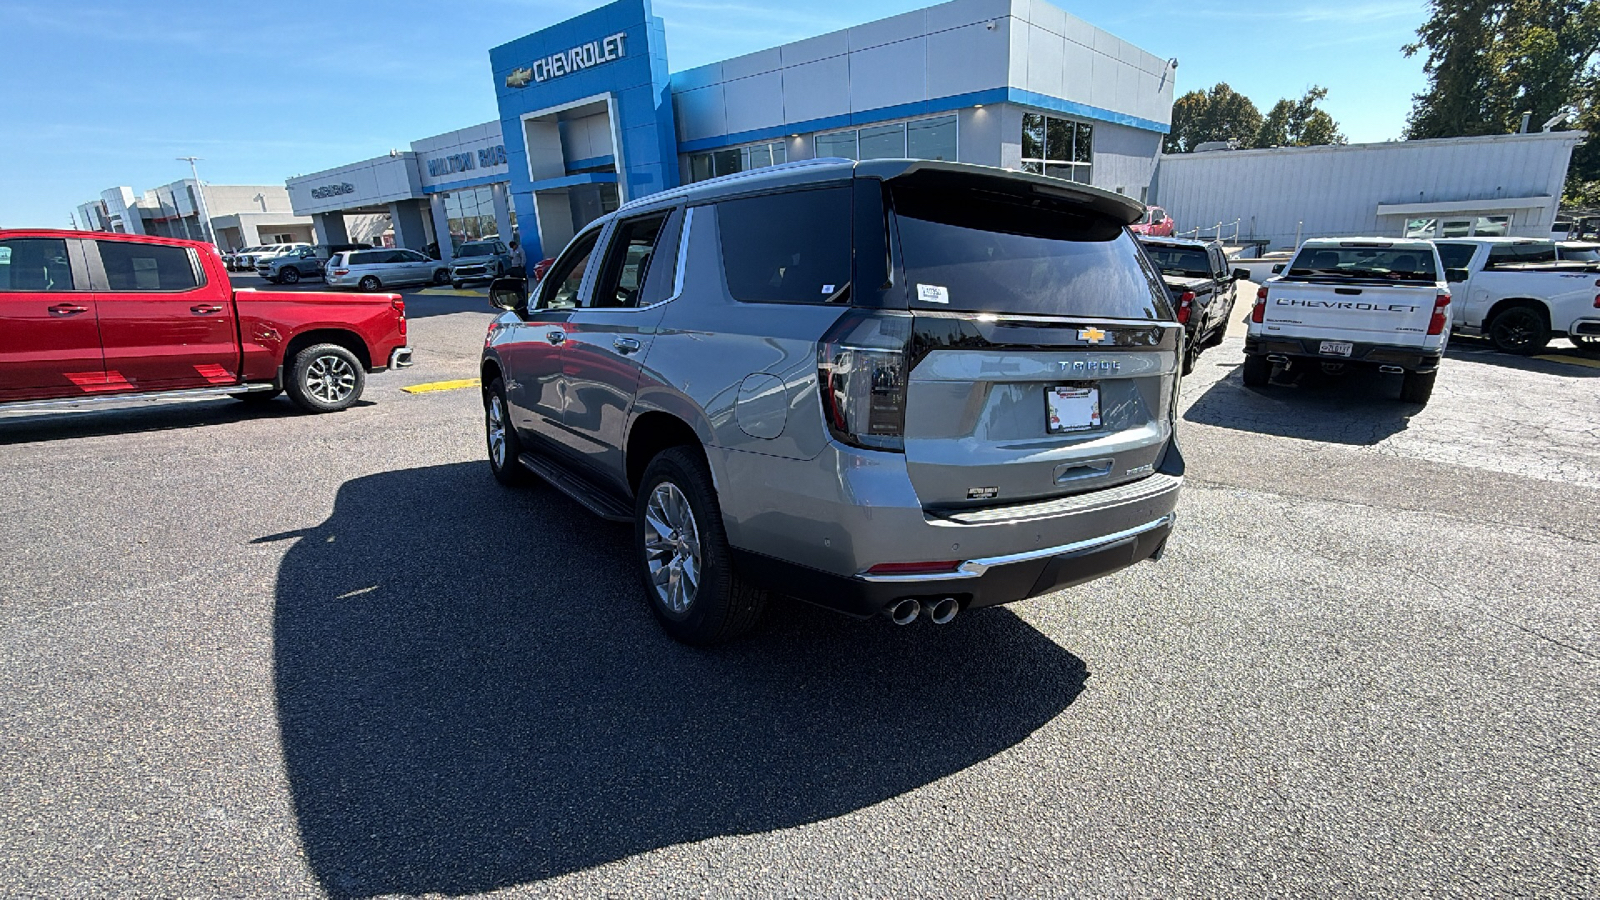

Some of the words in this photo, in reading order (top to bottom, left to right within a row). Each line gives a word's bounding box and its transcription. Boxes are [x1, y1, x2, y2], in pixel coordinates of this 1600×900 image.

[532, 32, 627, 82] CHEVROLET
[427, 151, 476, 177] MILTON
[1276, 298, 1420, 313] CHEVROLET
[1057, 360, 1121, 371] TAHOE
